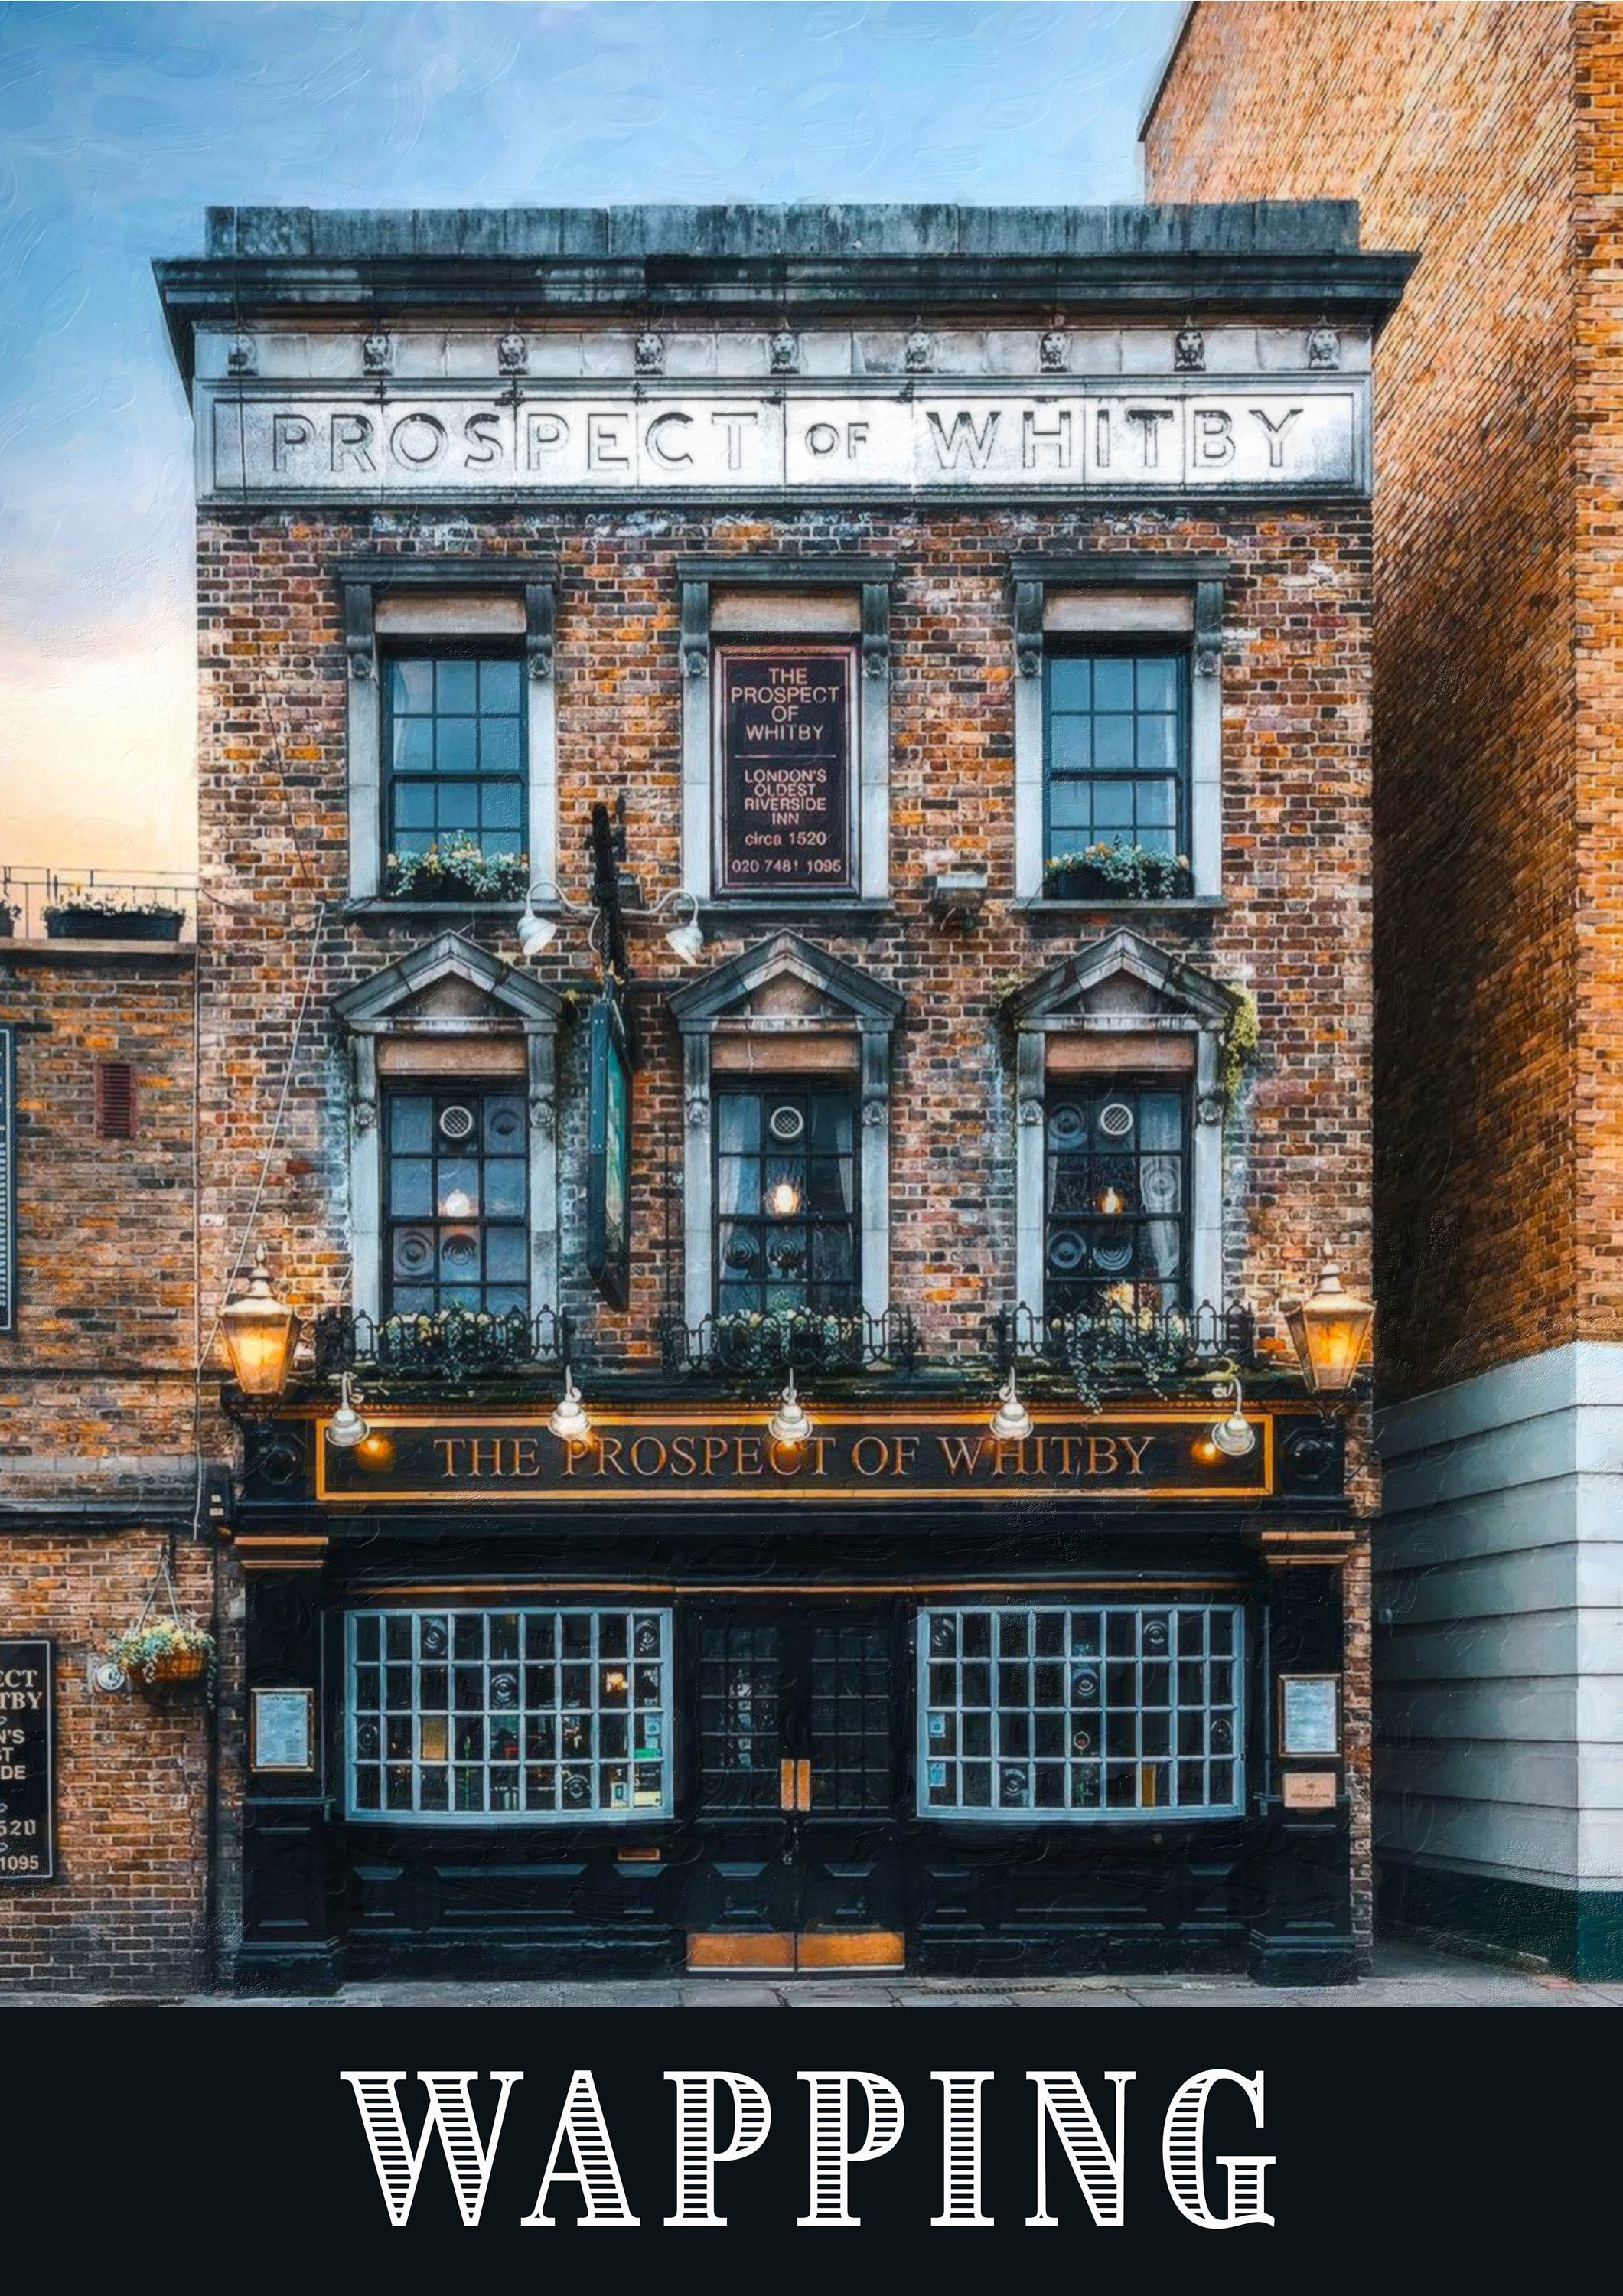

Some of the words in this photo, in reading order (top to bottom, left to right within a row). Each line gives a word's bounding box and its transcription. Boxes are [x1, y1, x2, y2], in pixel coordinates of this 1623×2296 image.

[272, 411, 758, 471] PROSPECT
[805, 422, 870, 459] OF
[925, 409, 1304, 468] WHITBY
[768, 667, 808, 686] THE
[731, 687, 840, 704] PROSPECT
[771, 705, 800, 722] OF
[745, 724, 824, 741] WHITBY
[744, 768, 828, 783] LONDON'S
[754, 783, 816, 797] OLDEST
[744, 797, 827, 811] RIVERSIDE
[771, 812, 800, 825] INN
[745, 831, 782, 846] circa
[789, 831, 827, 846] 1520
[731, 859, 760, 873] 020
[765, 859, 798, 873] 7481
[806, 859, 842, 874] 1095
[433, 1437, 543, 1478] THE
[561, 1435, 837, 1478] PROSPECT
[851, 1436, 920, 1476] OF
[935, 1436, 1156, 1477] WHITBY
